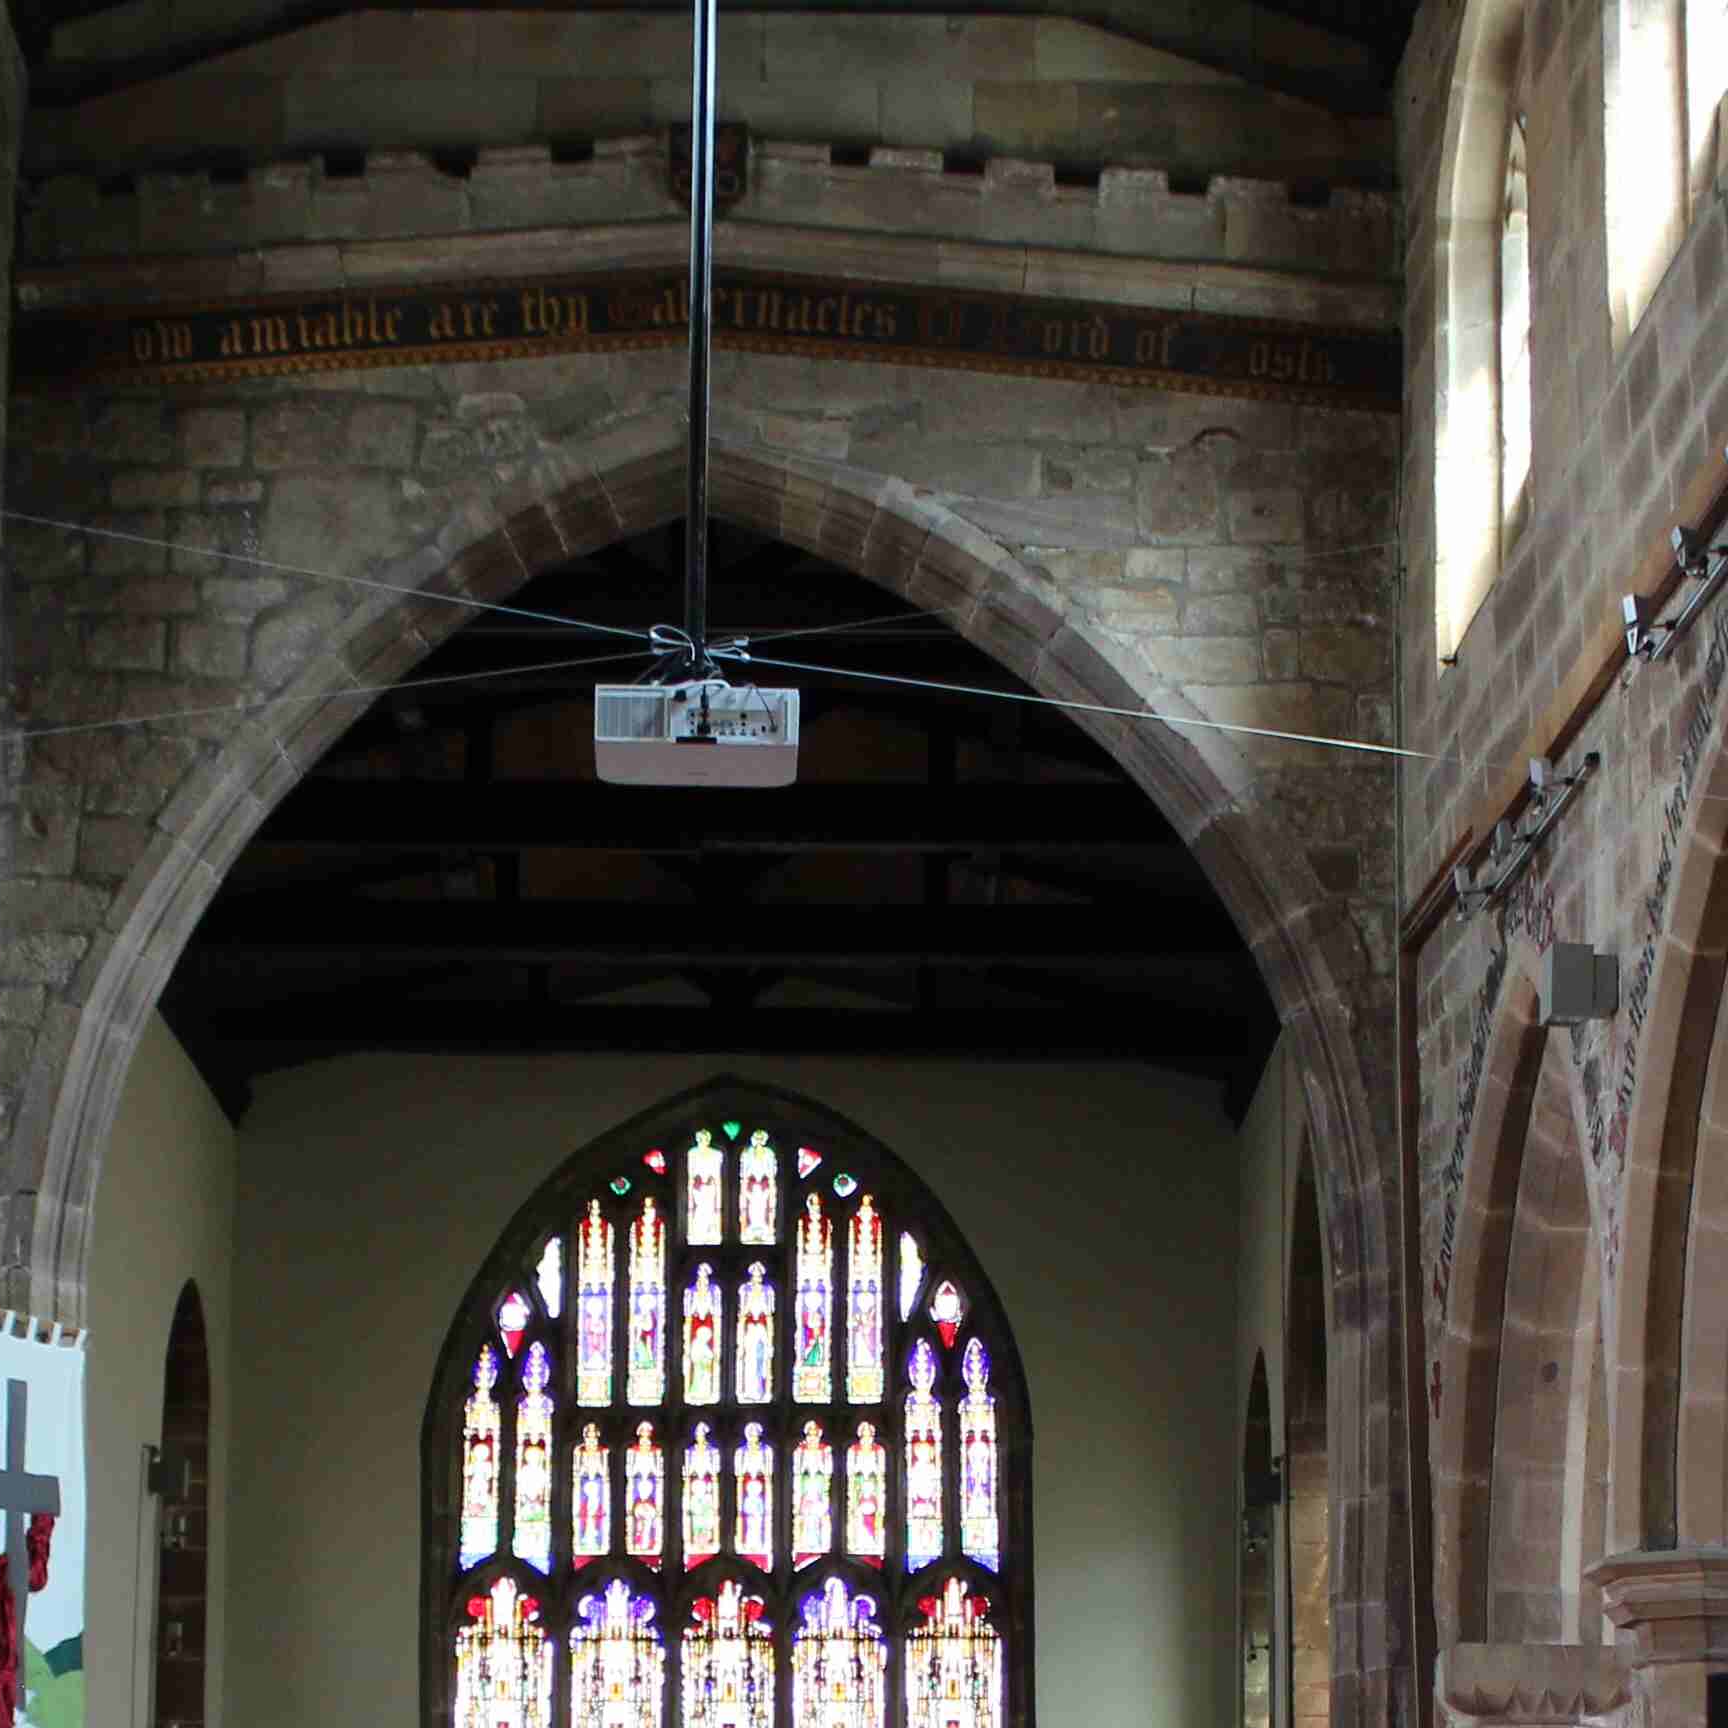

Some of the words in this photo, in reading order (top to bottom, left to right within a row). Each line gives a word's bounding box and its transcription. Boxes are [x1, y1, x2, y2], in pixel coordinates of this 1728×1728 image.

[219, 299, 403, 356] amiable
[428, 300, 496, 338] are
[519, 287, 590, 333] thy
